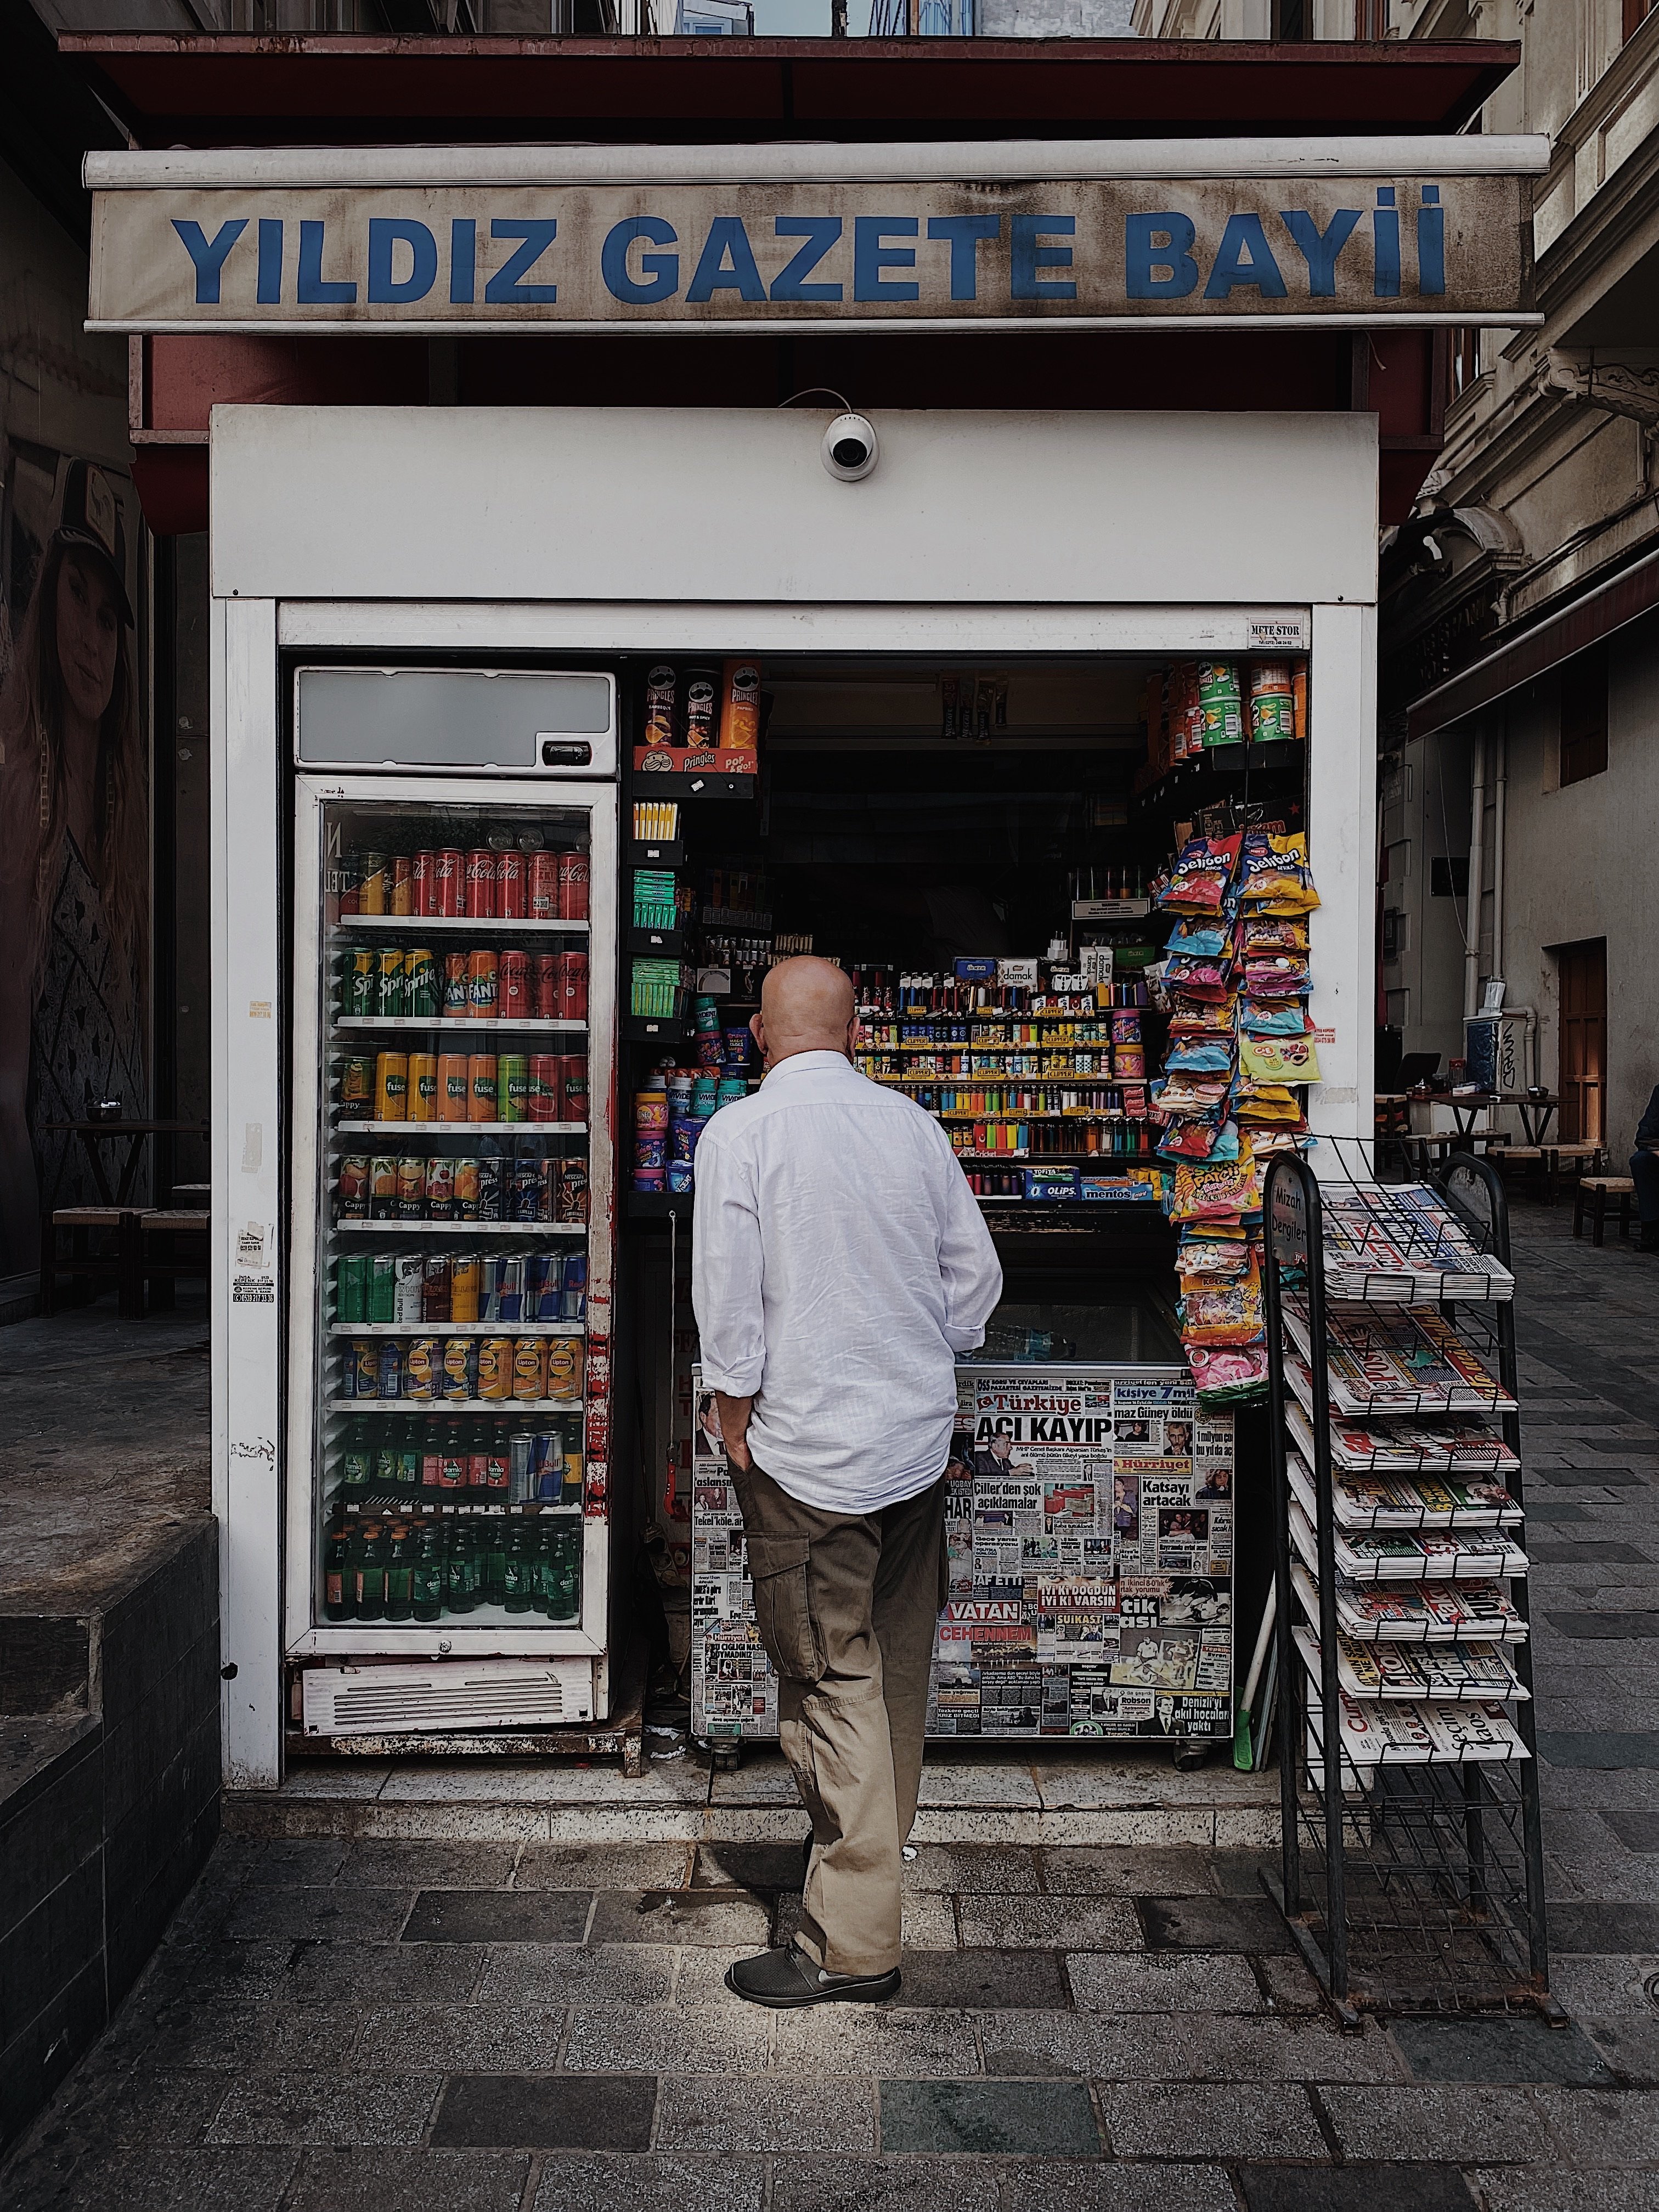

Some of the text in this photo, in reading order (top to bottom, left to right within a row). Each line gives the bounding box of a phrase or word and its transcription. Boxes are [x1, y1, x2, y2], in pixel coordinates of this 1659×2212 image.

[171, 185, 1446, 305] YILDIZ GAZETE BAYİİ
[1277, 625, 1299, 635] STOR
[732, 689, 758, 705] PRINGLES
[688, 701, 713, 714] PRINGLES
[684, 752, 716, 772] Pringles
[1178, 851, 1231, 874] Jelibon
[1246, 849, 1300, 873] Jelibon
[1003, 968, 1033, 980] damak
[1098, 955, 1109, 985] damak
[387, 1081, 405, 1091] fuse
[420, 1083, 437, 1091] fuse
[447, 1083, 466, 1092] fuse
[474, 1084, 494, 1093] fuse
[509, 1083, 527, 1093] fuse
[566, 1084, 583, 1093] fuse
[1193, 1165, 1240, 1188] PATCH
[1086, 1190, 1131, 1199] mentos
[1276, 1186, 1301, 1211] Mizah
[399, 1201, 421, 1211] Cappy
[430, 1201, 452, 1211] Cappy
[1271, 1213, 1306, 1243] Dergiler
[545, 1279, 559, 1288] Bull
[252, 1294, 261, 1302] 217
[261, 1294, 267, 1302] 33
[267, 1294, 273, 1303] 36
[1117, 1387, 1173, 1399] kişiye 7
[994, 1394, 1081, 1416] Türkiye
[1114, 1406, 1193, 1421] maz Güney öldü
[976, 1417, 1113, 1443] ACI KAYIP
[1200, 1431, 1223, 1443] milyon
[1122, 1459, 1190, 1470] Hürriyet
[974, 1482, 1041, 1497] Çiller'den şok
[1142, 1480, 1189, 1496] Katsayı
[978, 1496, 1037, 1510] açıklamalar
[1143, 1494, 1191, 1506] artacak
[945, 1496, 972, 1519] HAR
[695, 1516, 714, 1526] Tekel
[1127, 1578, 1165, 1587] ikinci 8-0'lık
[1041, 1584, 1116, 1596] İYİ Kİ DOĞDUN
[1041, 1595, 1116, 1607] İYİ Kİ VARSIN
[1121, 1599, 1156, 1614] tik
[949, 1602, 1018, 1620] VATAN
[1057, 1615, 1102, 1624] SUİKAST
[714, 1634, 746, 1642] Hürriyet
[939, 1626, 1032, 1641] CEHENNEM
[1182, 1696, 1222, 1709] Denizli'yi
[1175, 1710, 1192, 1720] akıl
[1187, 1720, 1211, 1733] yaktı
[1436, 1706, 1474, 1751] Seçim
